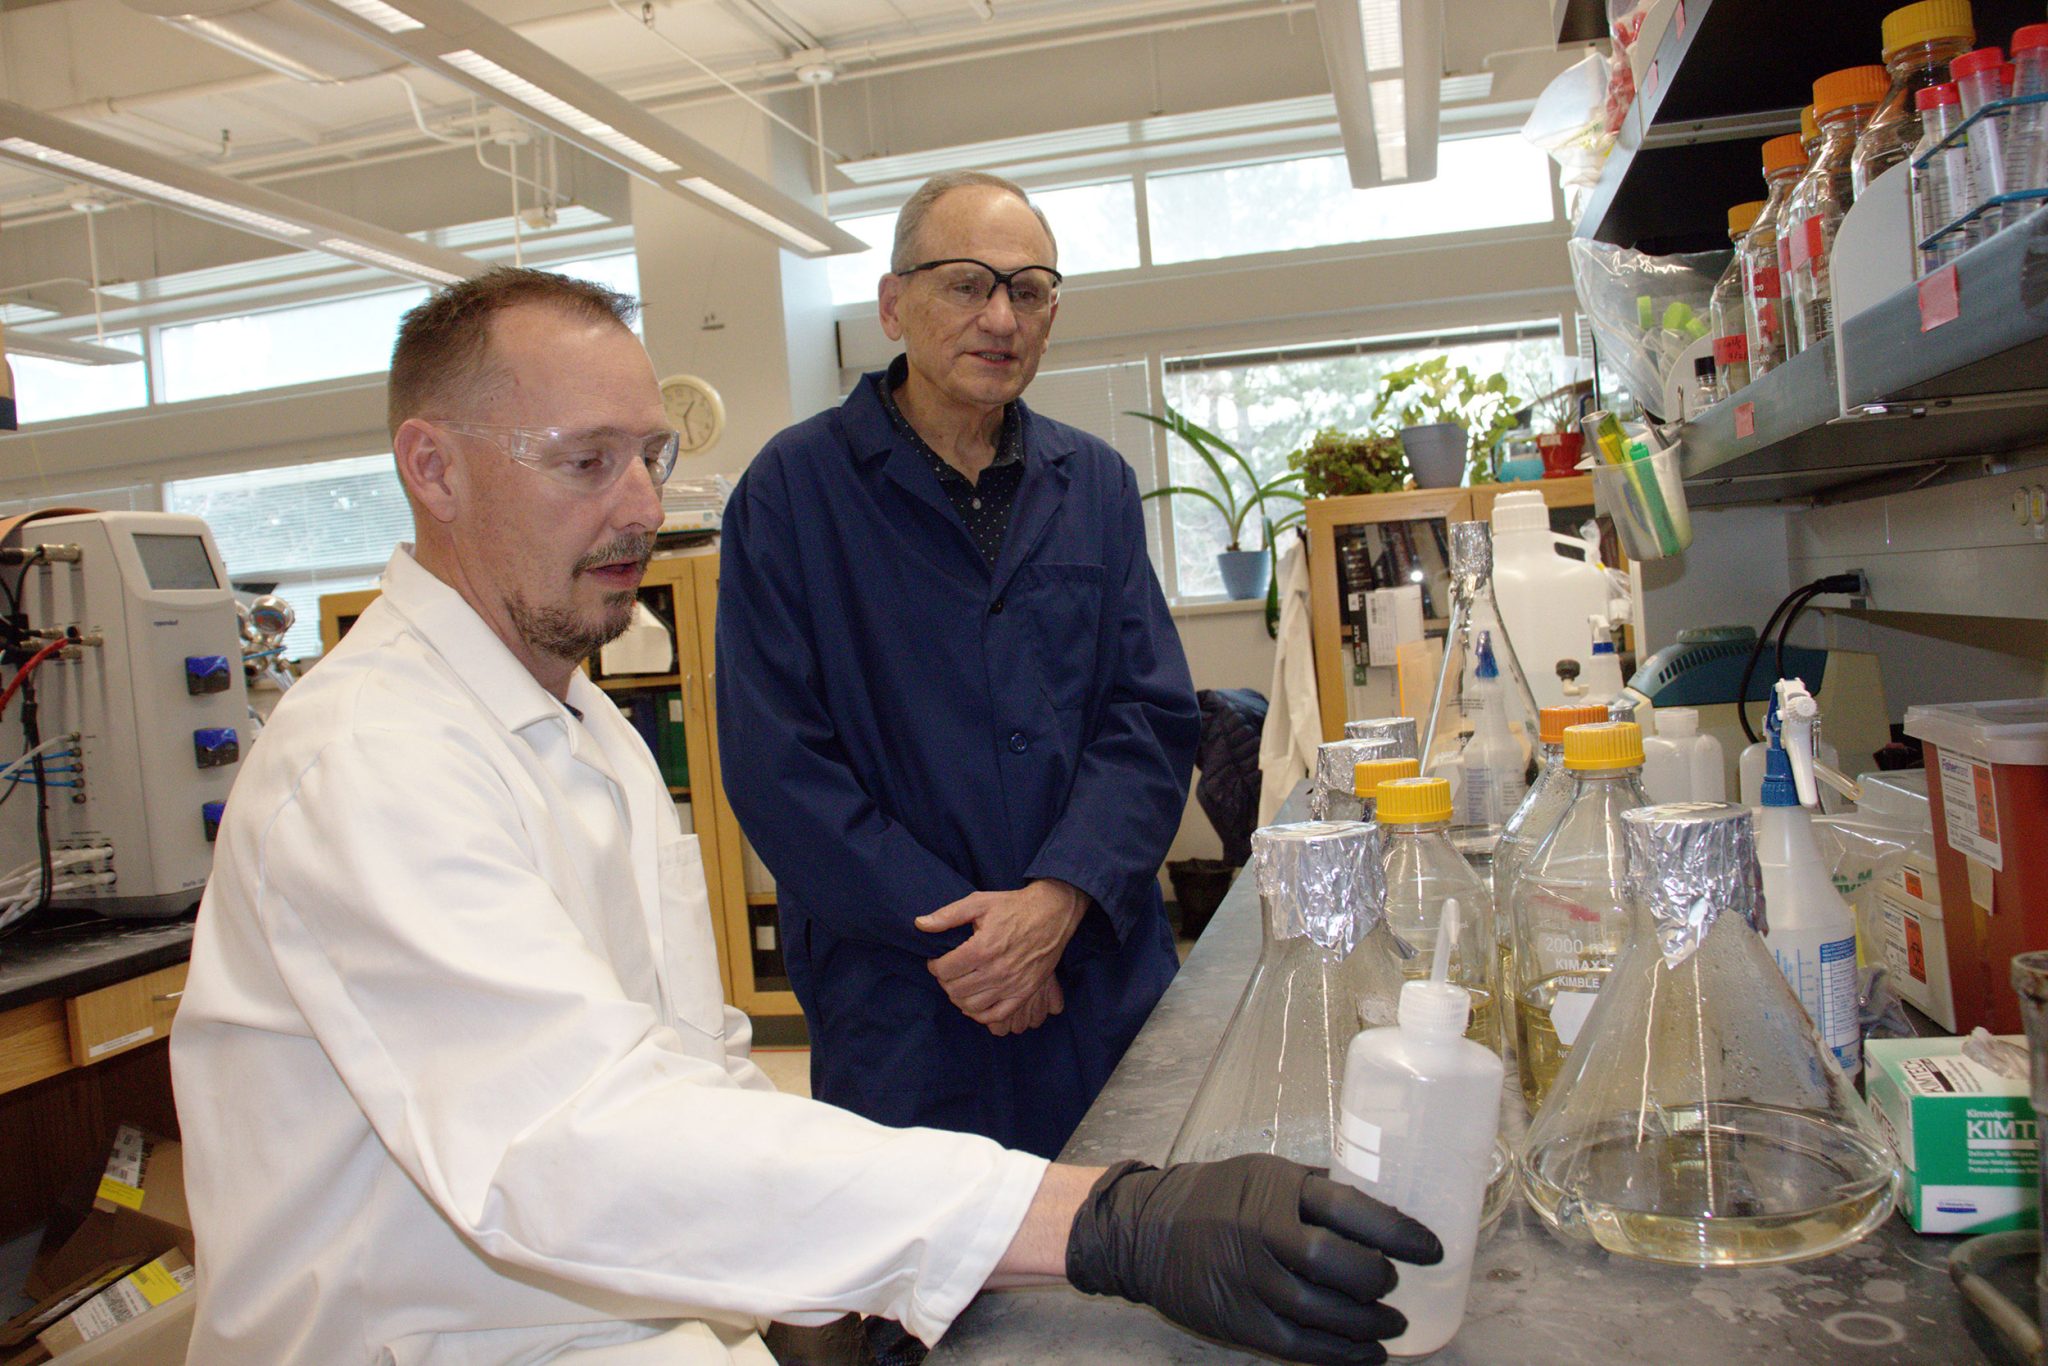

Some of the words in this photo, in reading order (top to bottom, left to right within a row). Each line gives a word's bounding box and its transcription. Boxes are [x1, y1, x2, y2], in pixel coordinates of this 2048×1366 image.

[1546, 937, 1584, 954] 2000
[1555, 959, 1601, 971] KIMAX
[1558, 975, 1601, 989] KIMBLE
